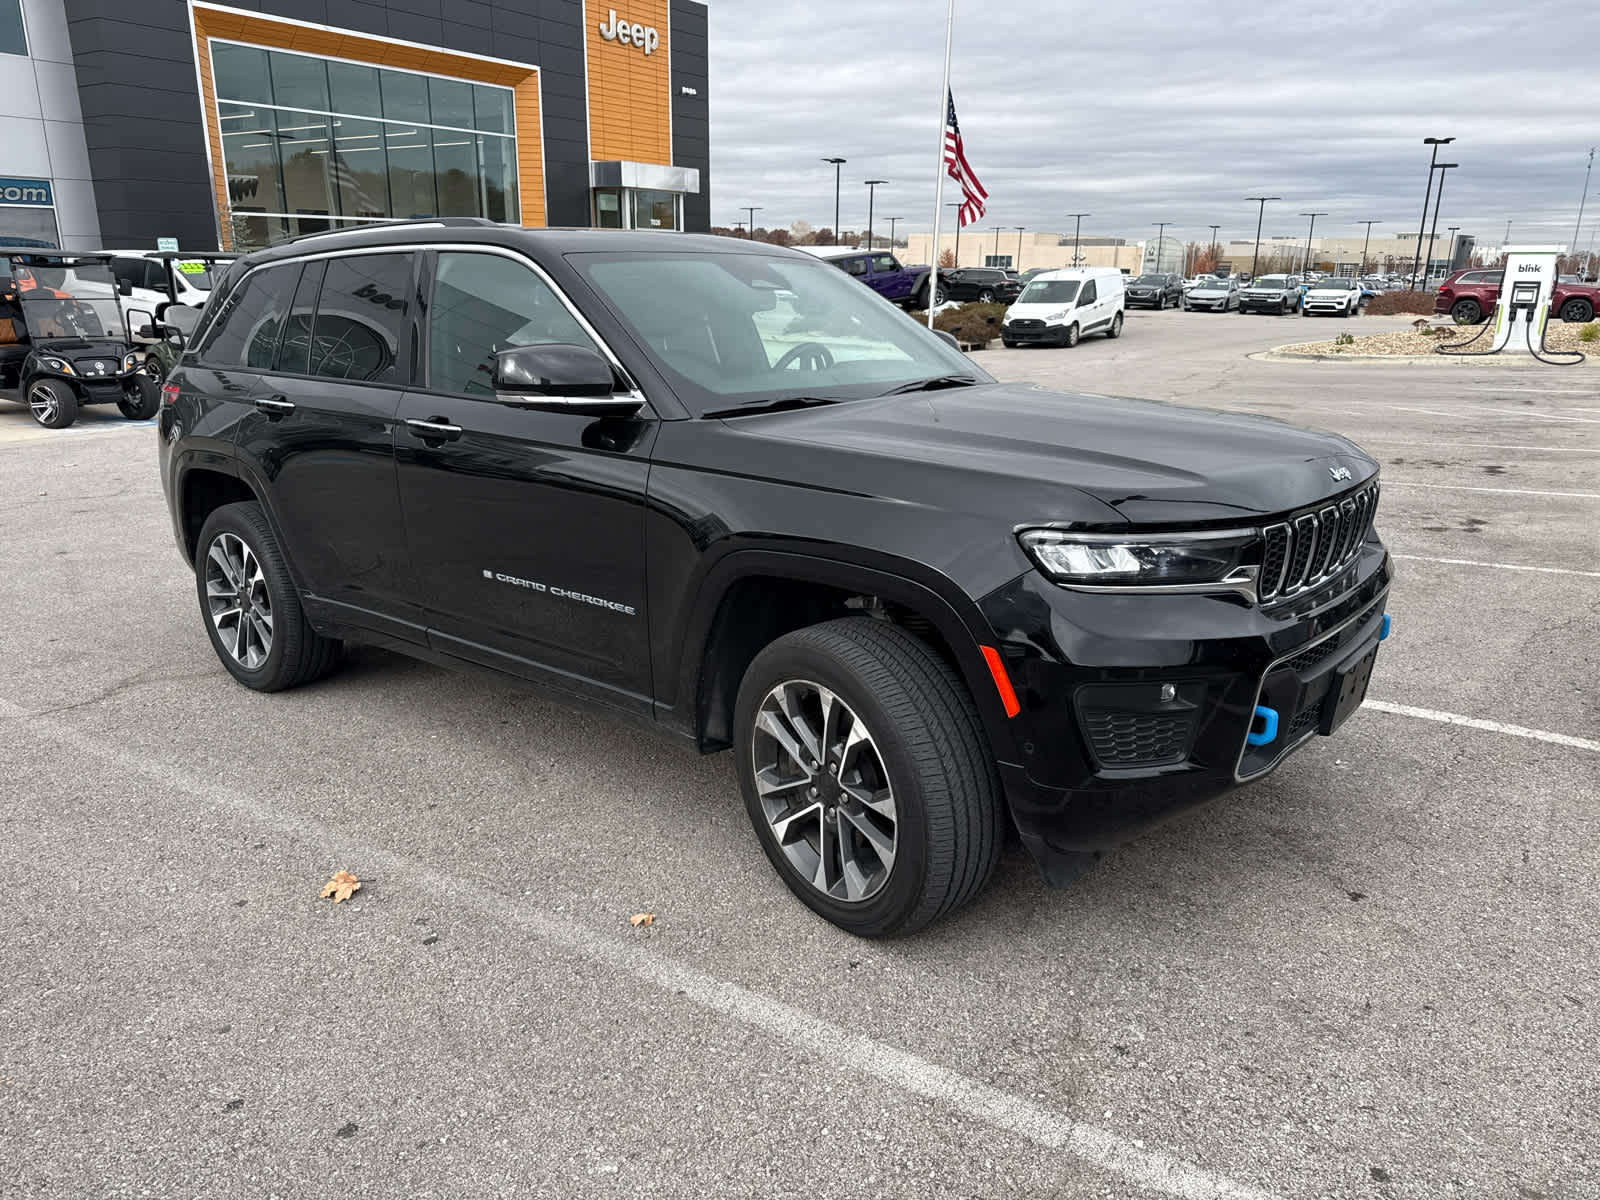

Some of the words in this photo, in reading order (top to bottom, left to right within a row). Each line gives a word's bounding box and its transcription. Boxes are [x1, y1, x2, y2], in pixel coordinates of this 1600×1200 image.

[599, 8, 659, 56] Jeep
[0, 186, 47, 202] om
[1518, 263, 1542, 273] blink
[495, 573, 547, 592] GRAND
[550, 586, 635, 616] CHEROKEE
